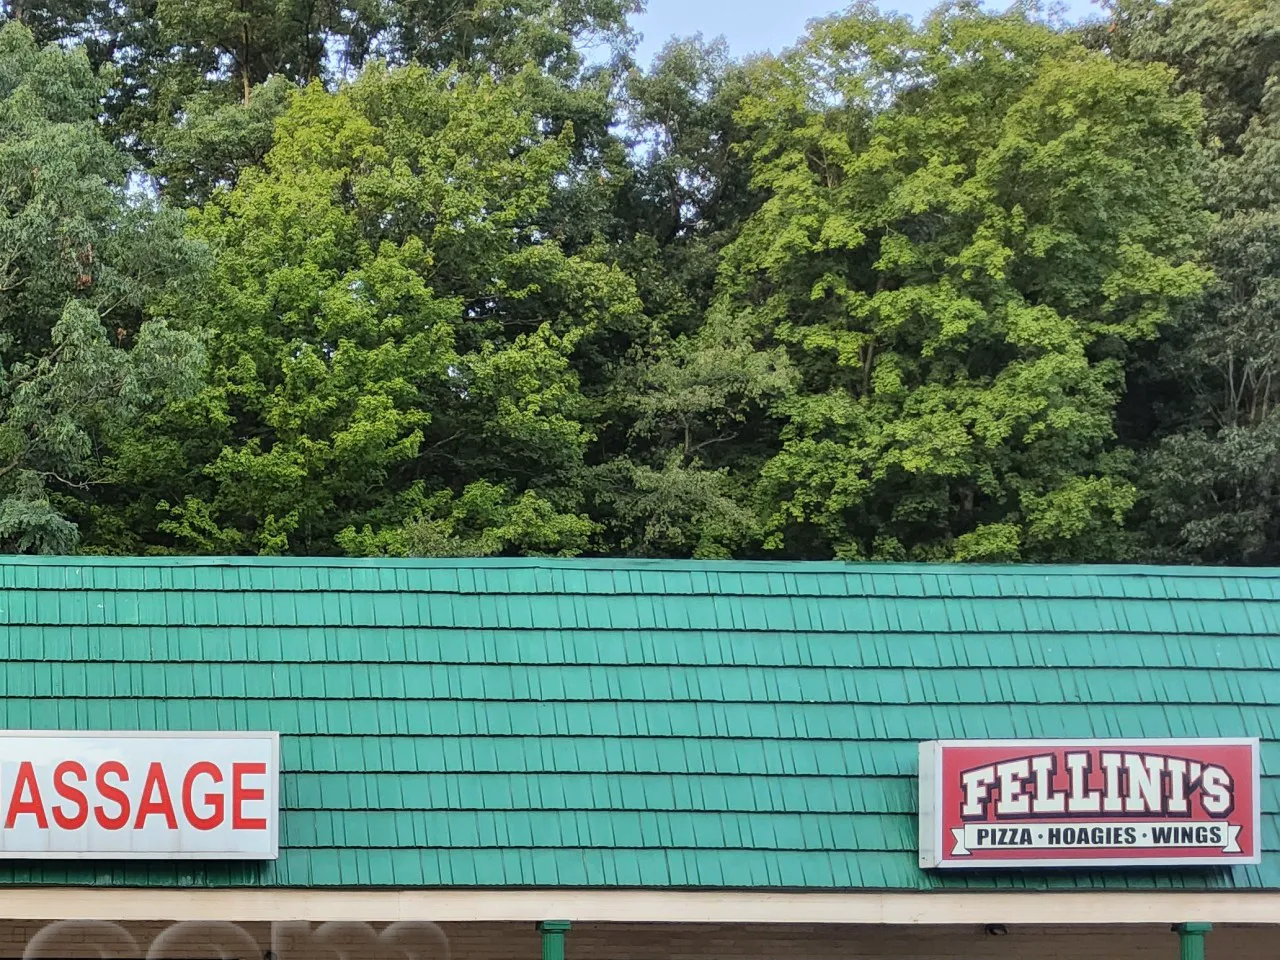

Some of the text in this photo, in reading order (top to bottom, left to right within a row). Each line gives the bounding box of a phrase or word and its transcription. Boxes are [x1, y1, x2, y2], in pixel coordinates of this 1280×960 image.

[961, 750, 1234, 820] FELLINI'S
[977, 826, 1222, 845] PIZZA HOAGIES WINGS
